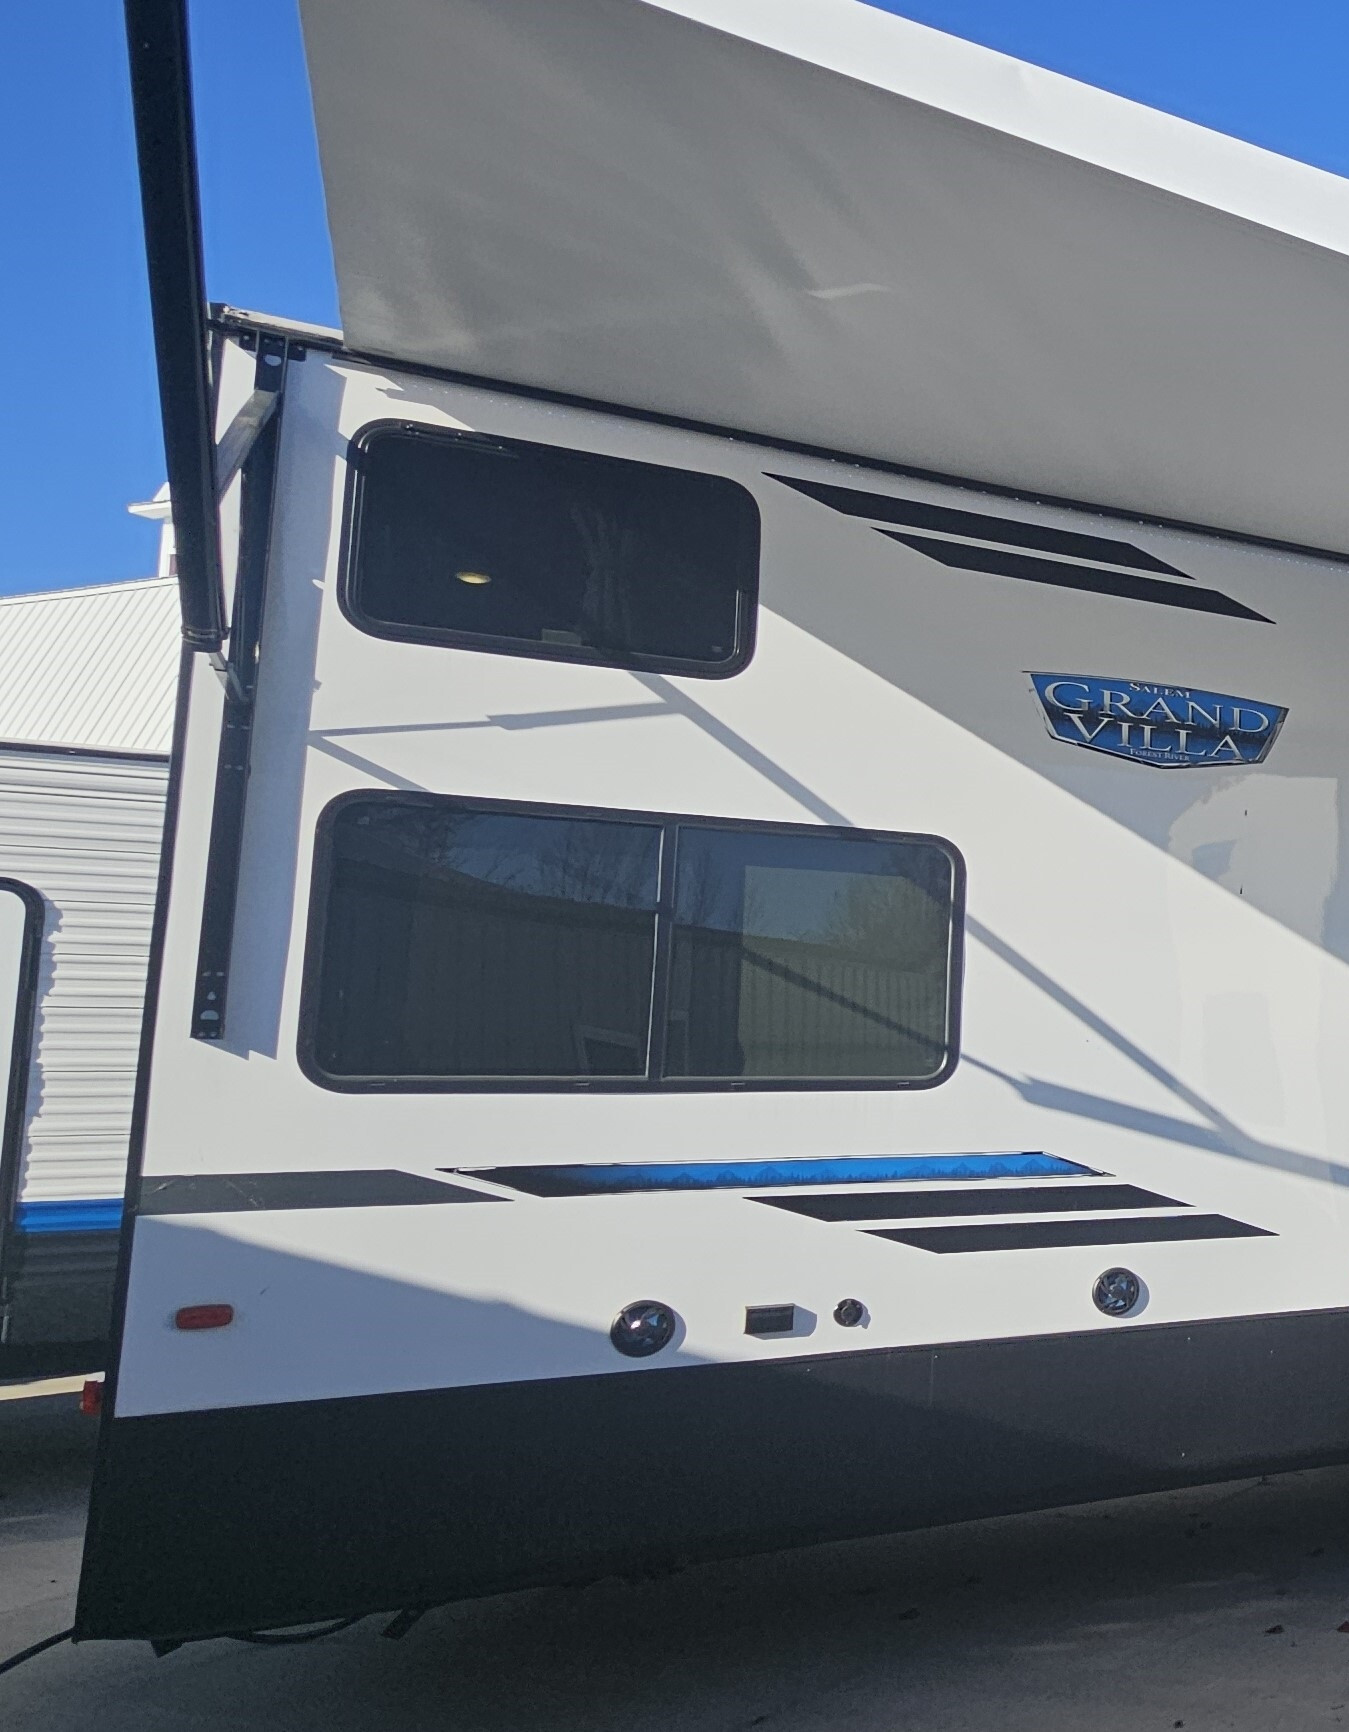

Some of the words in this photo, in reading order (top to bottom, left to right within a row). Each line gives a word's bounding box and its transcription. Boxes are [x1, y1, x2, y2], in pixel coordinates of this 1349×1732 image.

[1044, 681, 1270, 733] GRAND
[1129, 683, 1191, 699] SALEM
[1063, 712, 1246, 761] VILLA
[1129, 747, 1163, 759] FOREST
[1164, 752, 1190, 762] RIVER
